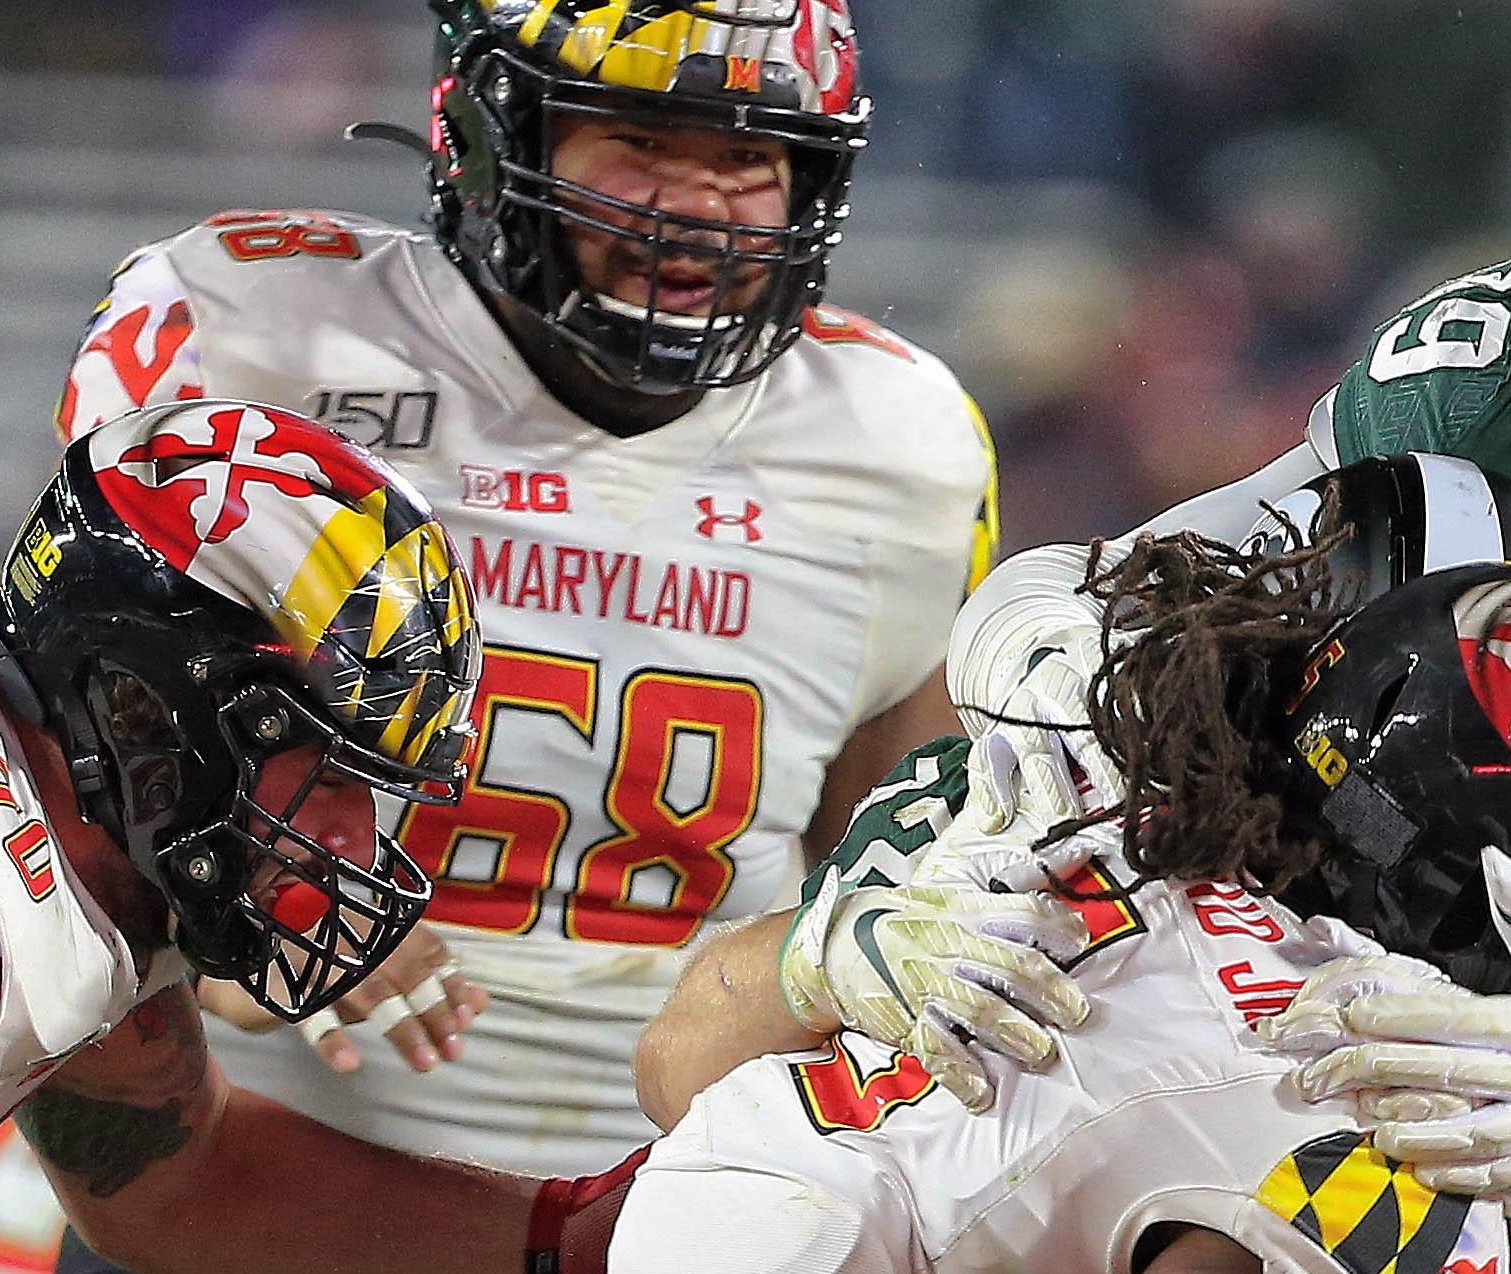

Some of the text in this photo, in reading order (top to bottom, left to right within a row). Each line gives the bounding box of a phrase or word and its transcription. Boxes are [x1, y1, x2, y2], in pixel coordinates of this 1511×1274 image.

[724, 56, 761, 93] M
[472, 533, 751, 639] MARYLAND
[395, 643, 766, 948] 68
